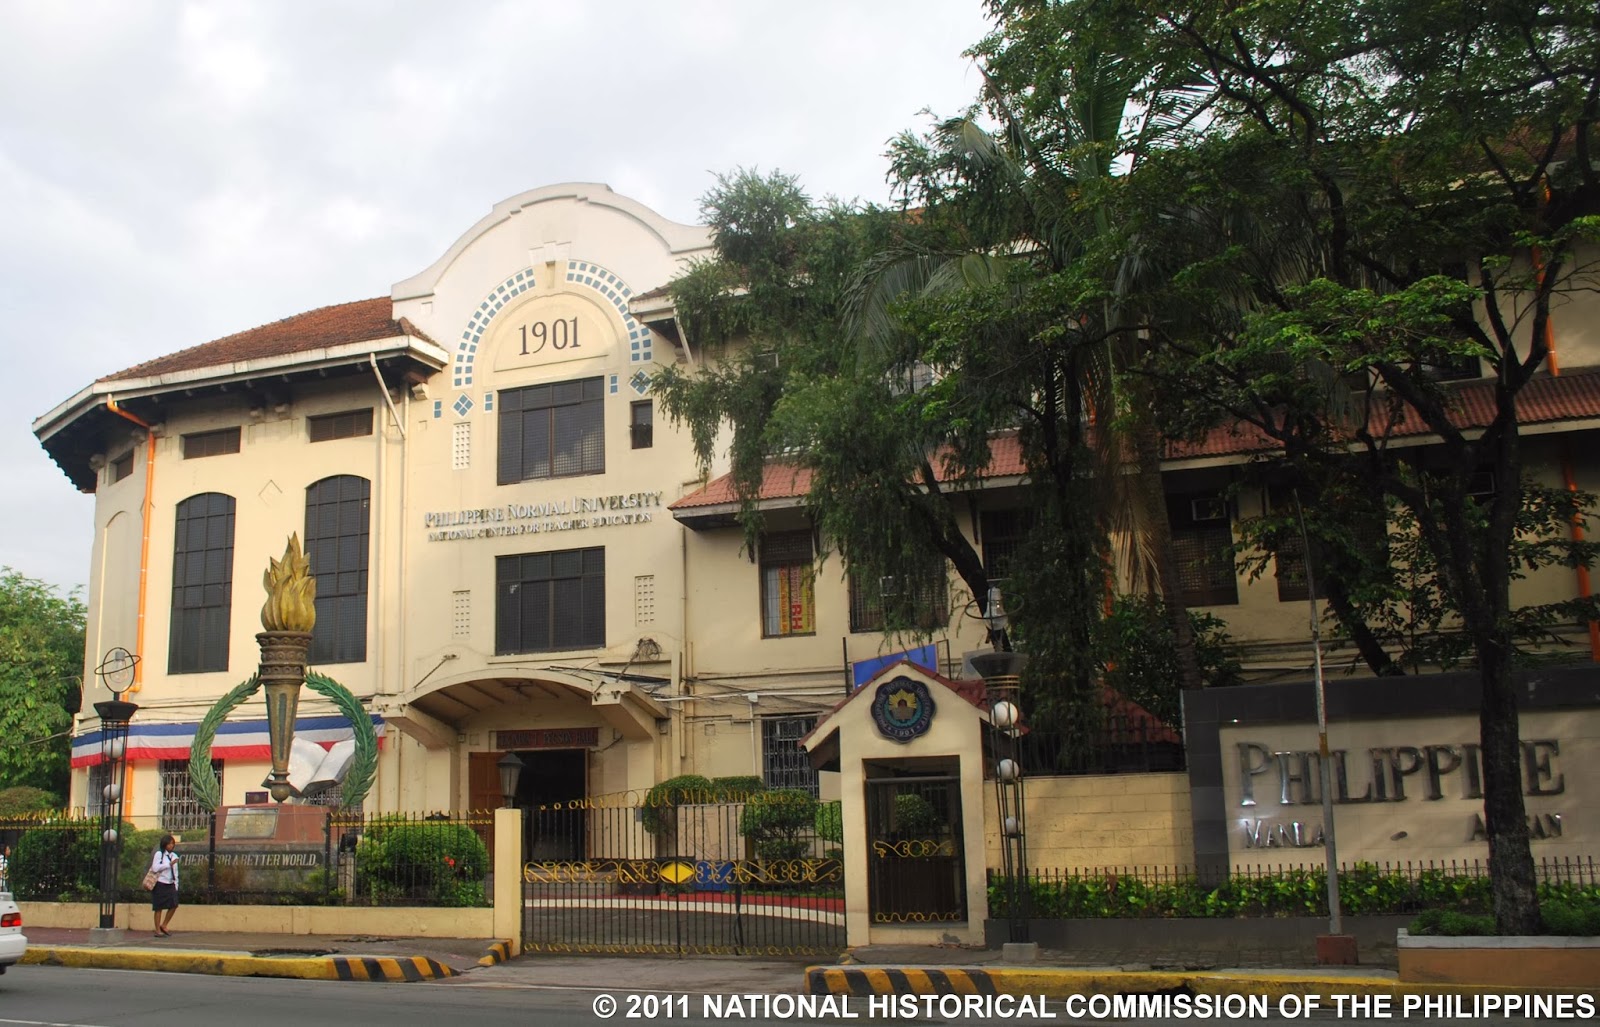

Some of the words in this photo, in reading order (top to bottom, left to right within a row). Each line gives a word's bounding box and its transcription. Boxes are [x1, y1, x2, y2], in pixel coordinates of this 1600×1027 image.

[518, 316, 582, 356] 1901
[424, 507, 504, 528] PHILIPPINE
[508, 500, 570, 520] NORMAL
[572, 491, 663, 514] UNIVERSITY
[428, 525, 475, 542] NATIONAL
[477, 522, 518, 538] CENTER
[520, 521, 540, 535] FOR
[542, 517, 589, 533] TEACHER
[591, 511, 653, 528] EDUCATION
[1237, 740, 1565, 806] PHLIPPIE
[241, 853, 281, 867] BETTER
